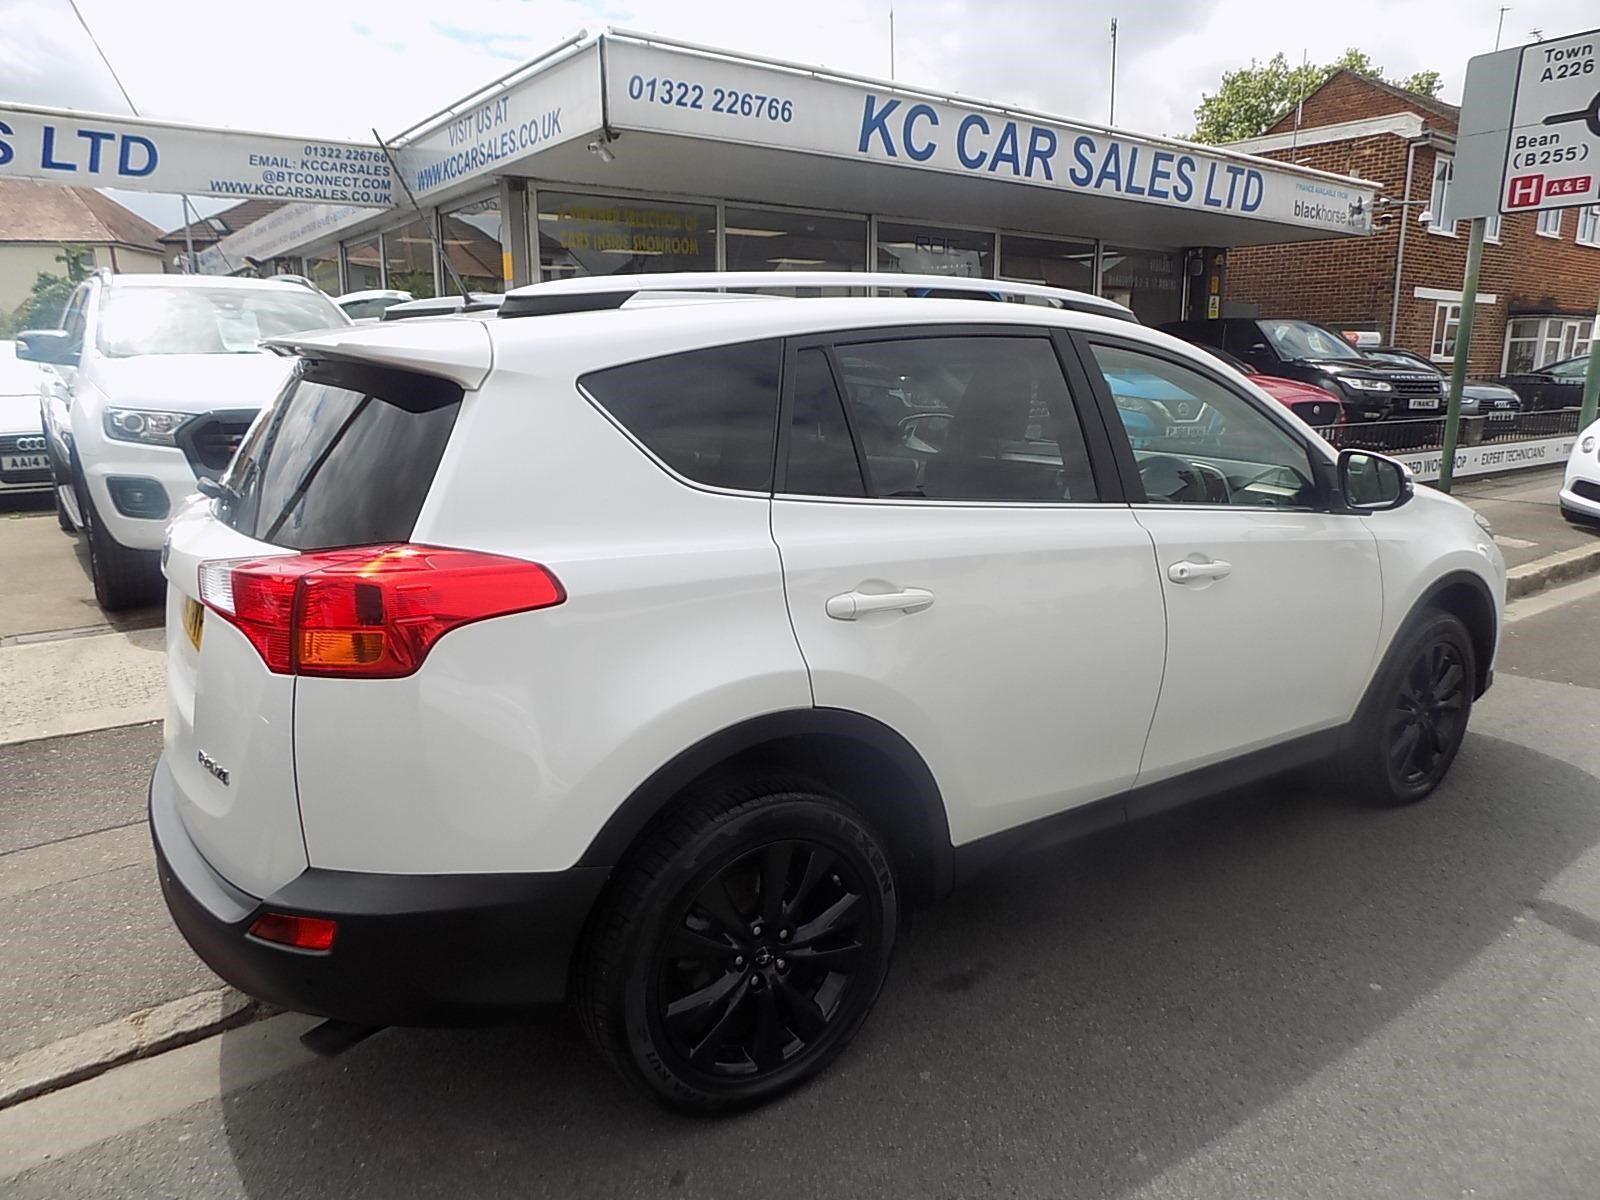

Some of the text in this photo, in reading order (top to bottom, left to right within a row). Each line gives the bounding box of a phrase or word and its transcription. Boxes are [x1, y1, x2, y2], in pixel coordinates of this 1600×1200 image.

[1544, 44, 1593, 63] Town
[1540, 59, 1595, 83] A226
[628, 75, 793, 123] 01322 226766
[448, 96, 509, 147] VISIT US AT
[41, 126, 158, 177] LTD
[416, 107, 562, 191] WWW.KCCARSALES.CO.UK
[858, 94, 1264, 212] KC CAR SALES LTD
[1515, 133, 1560, 150] Bean
[249, 154, 390, 177] EMAIL: KCCARSALES
[304, 145, 387, 163] 01322 226766
[1513, 144, 1589, 170] (B255)
[210, 180, 392, 204] WWW.KCCARSALES.CO.UK
[262, 170, 391, 190] @BTCONNECT.COM
[1513, 177, 1538, 205] H
[632, 235, 700, 255] SHOWROOM
[1481, 451, 1504, 465] EXPERT
[1506, 446, 1546, 462] TECHNICIANS
